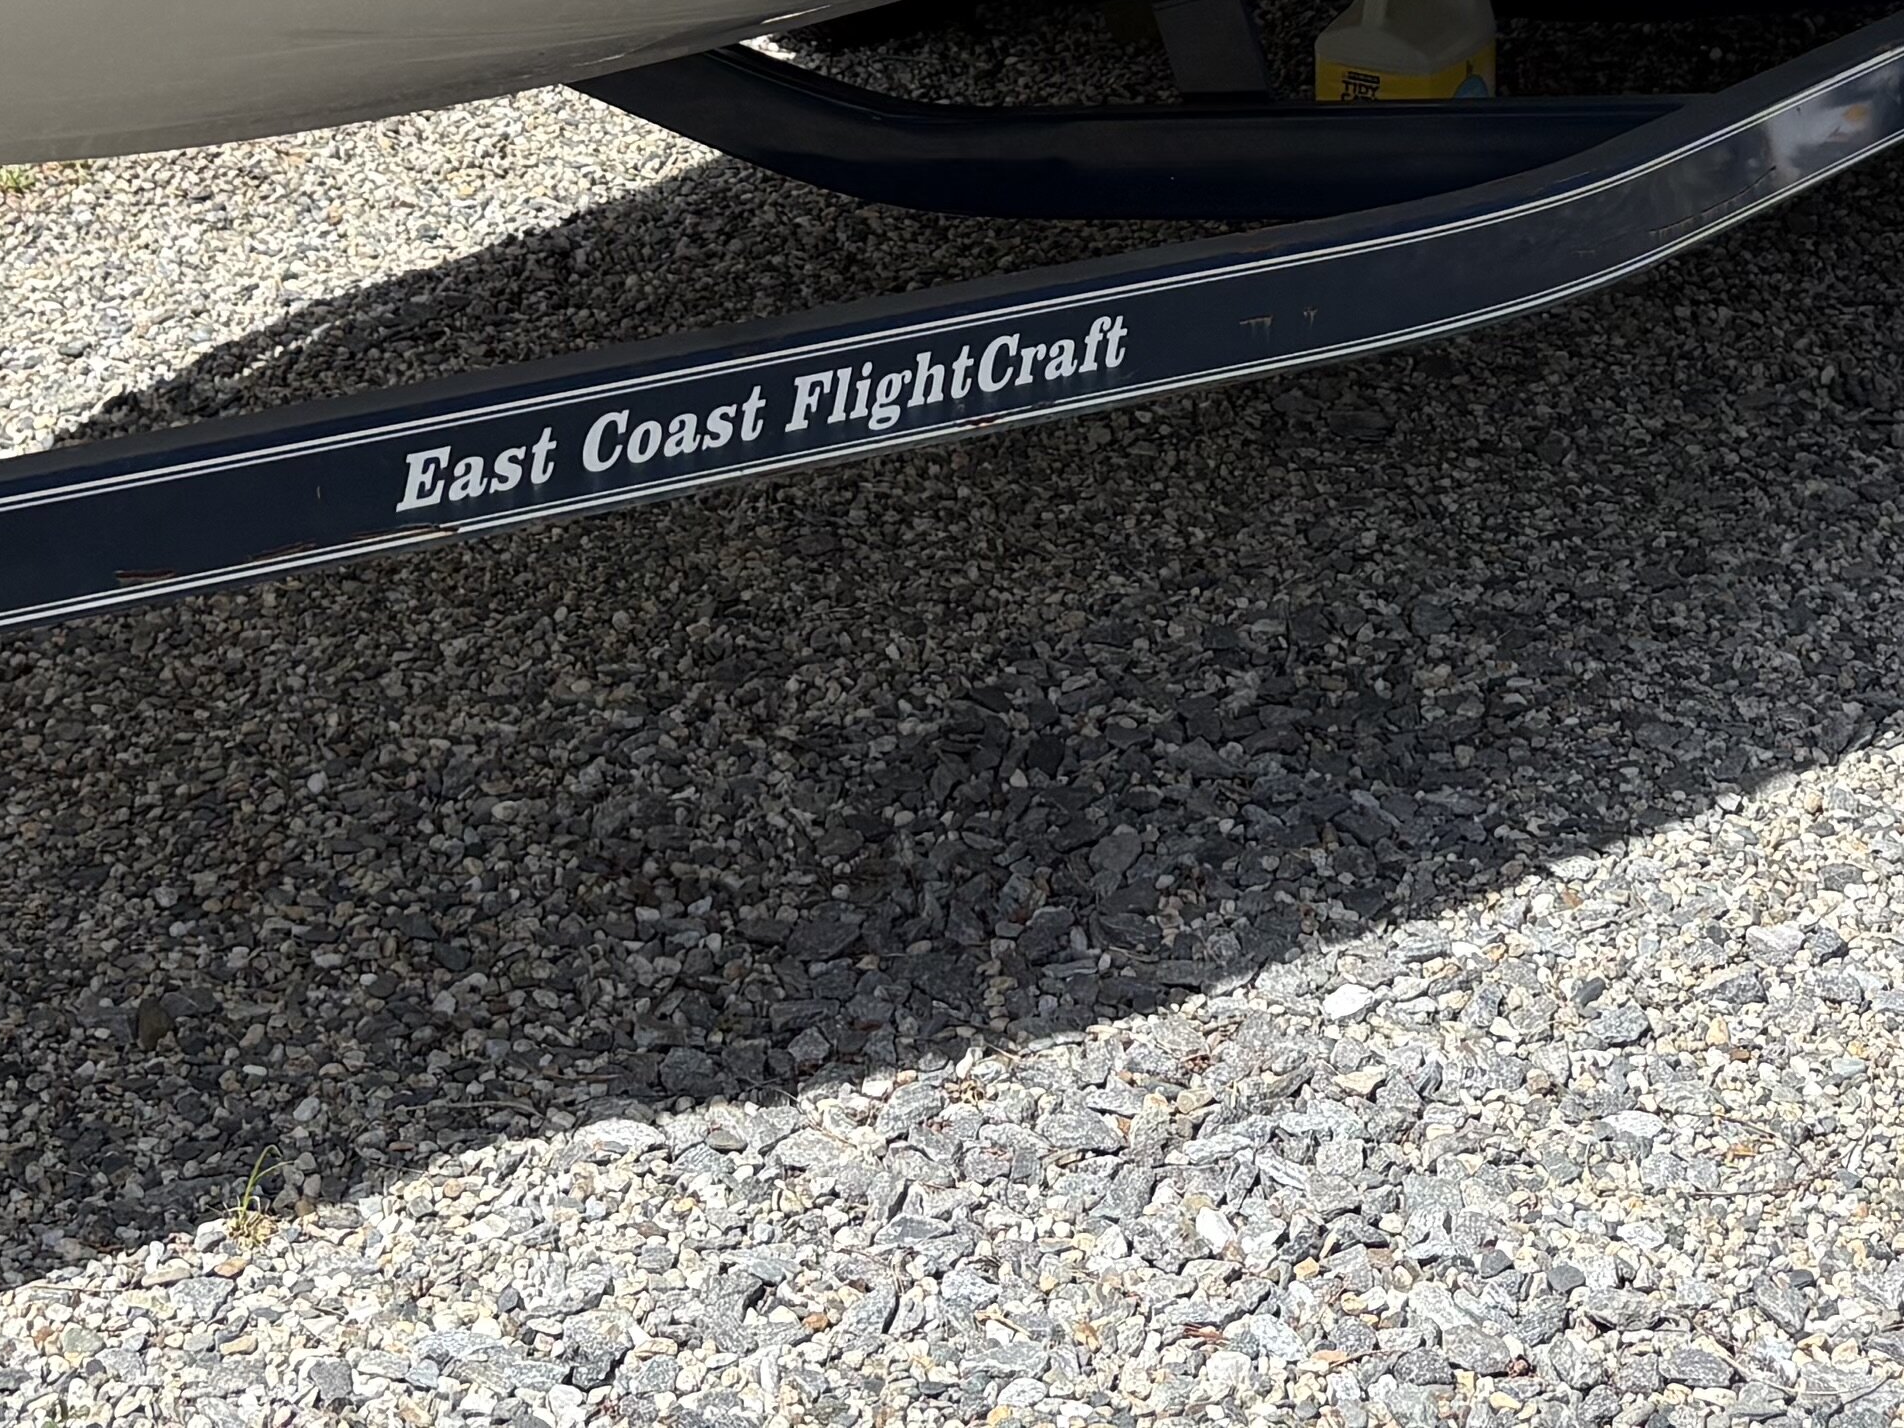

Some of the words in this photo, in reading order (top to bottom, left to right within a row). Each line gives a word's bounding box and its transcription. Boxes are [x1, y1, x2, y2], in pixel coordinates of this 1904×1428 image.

[396, 426, 557, 512] East
[583, 385, 766, 472] Coast
[786, 315, 1129, 434] FlightCraft
